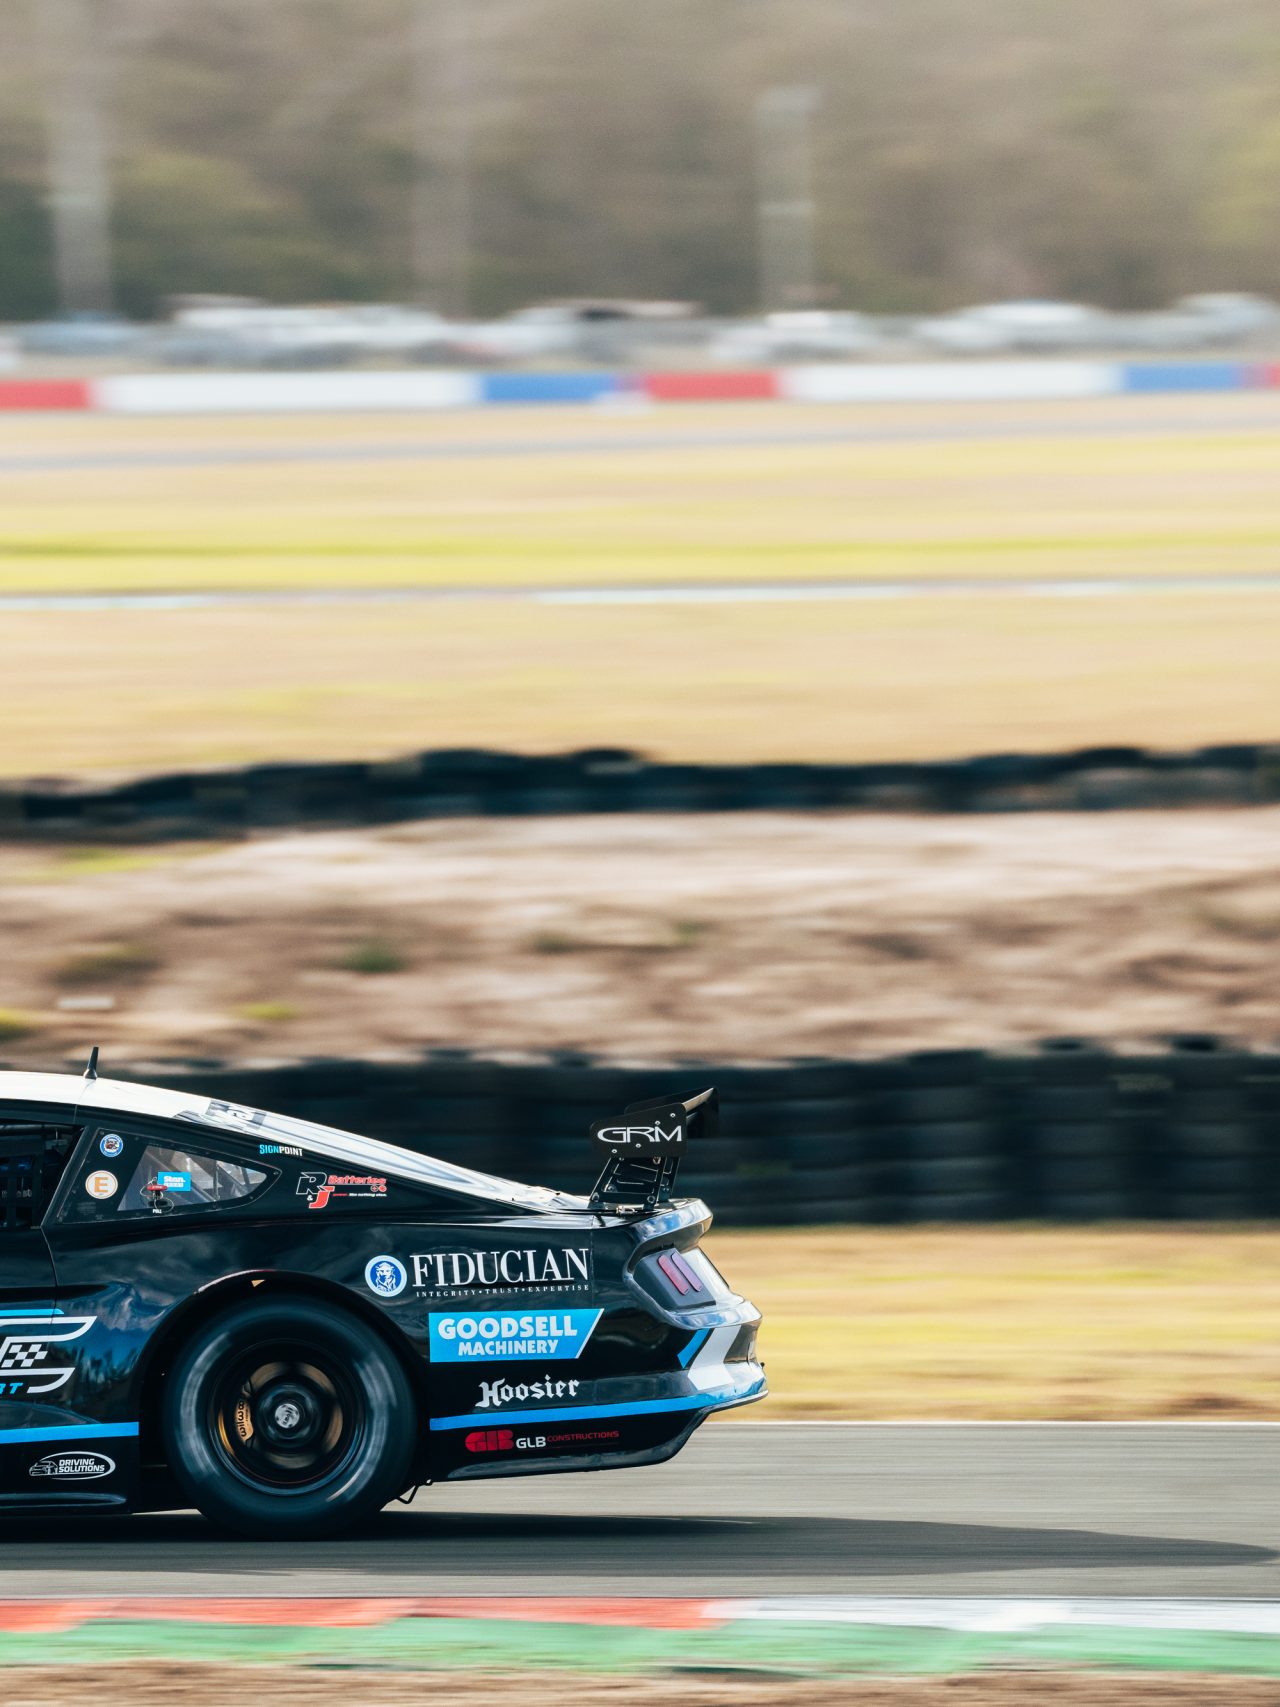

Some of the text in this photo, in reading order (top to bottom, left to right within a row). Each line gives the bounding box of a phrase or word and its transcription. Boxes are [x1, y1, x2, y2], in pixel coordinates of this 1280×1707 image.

[597, 1125, 682, 1143] GRM
[260, 1144, 303, 1157] SIGNPOINT
[94, 1176, 109, 1193] E
[328, 1175, 387, 1185] Batteries
[409, 1248, 589, 1287] FIDUCIAN
[416, 1284, 589, 1298] INTEGRITY TRUST EXPERTISE
[437, 1315, 578, 1340] GOODSELL
[458, 1339, 559, 1356] MACHINERY
[475, 1374, 580, 1408] Hoosier
[516, 1430, 620, 1449] GLB CONSTRUCTIONS
[58, 1464, 106, 1473] SOLUTIONS
[59, 1458, 95, 1466] DRIVING
